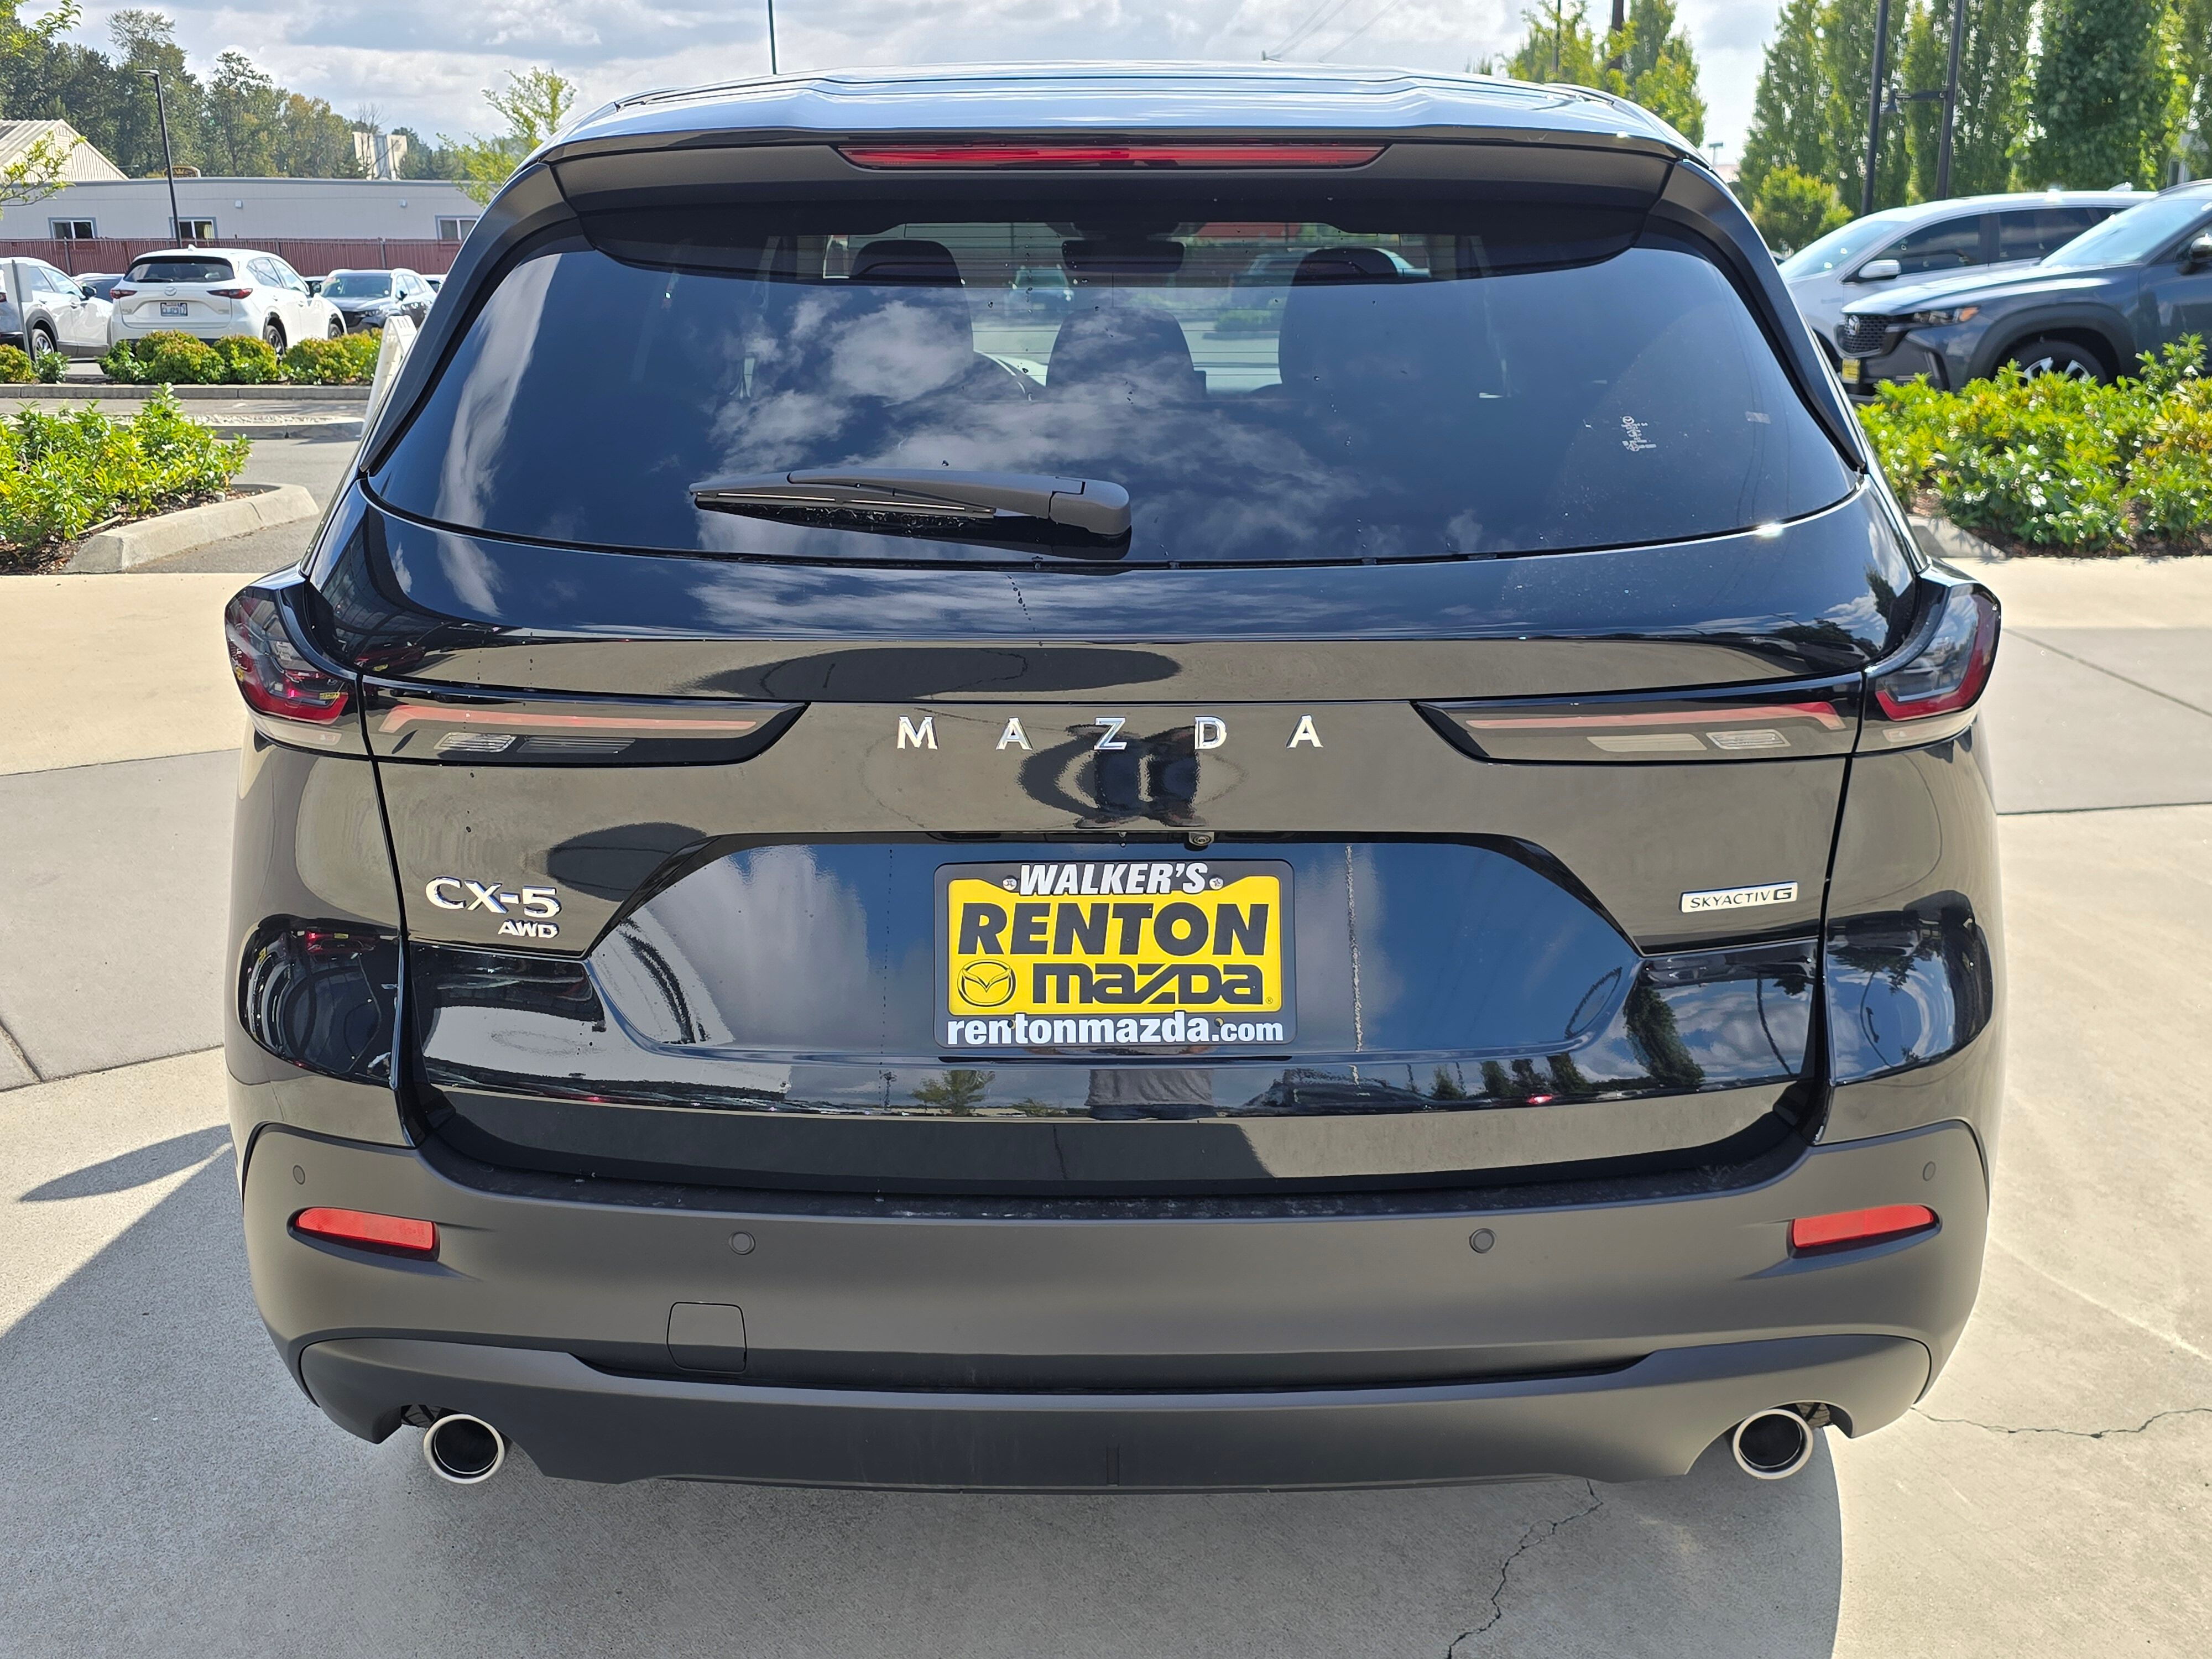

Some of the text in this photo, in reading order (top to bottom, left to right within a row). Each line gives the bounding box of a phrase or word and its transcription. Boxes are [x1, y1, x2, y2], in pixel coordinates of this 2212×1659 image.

[897, 715, 1323, 750] MAZDA
[1019, 863, 1208, 895] WALKER'S
[425, 877, 561, 918] CX-5
[498, 919, 559, 938] AWD
[958, 902, 1269, 956] RENTON
[947, 1011, 1284, 1045] rentonmazda.com
